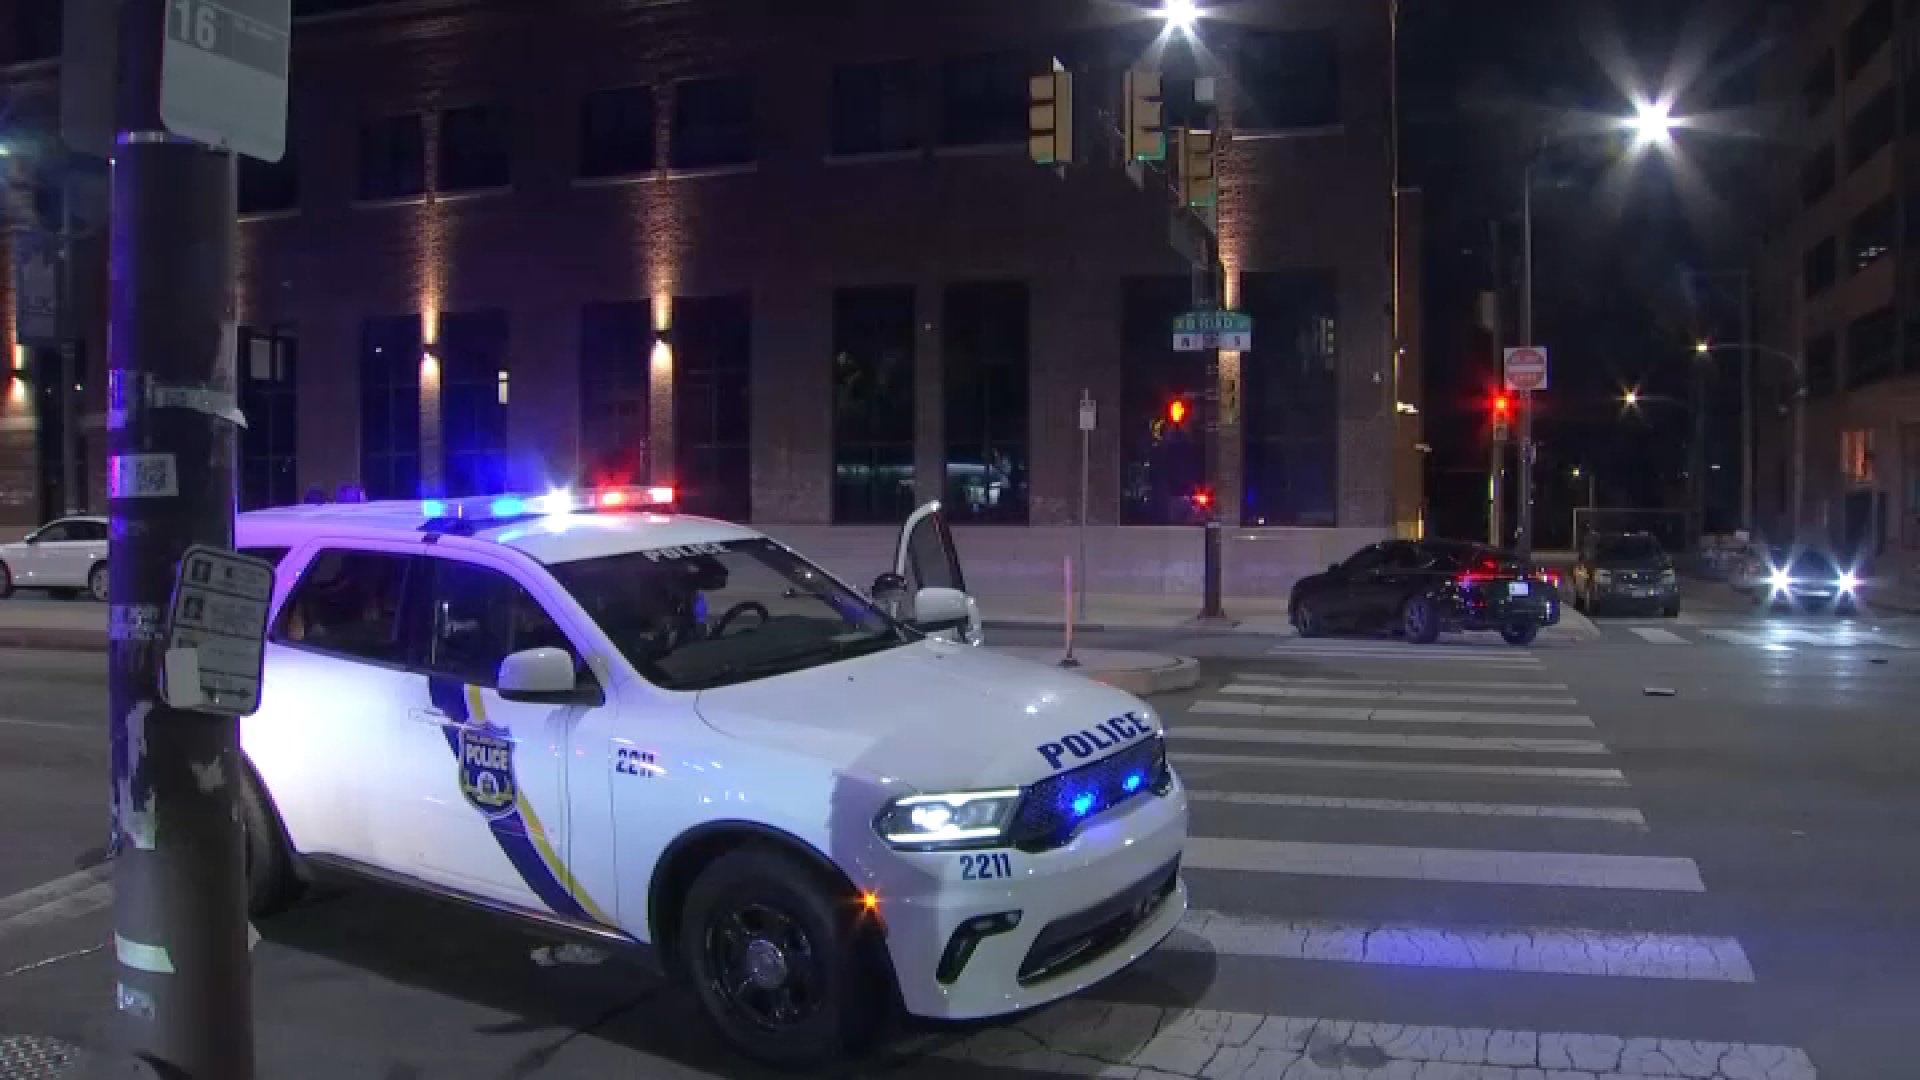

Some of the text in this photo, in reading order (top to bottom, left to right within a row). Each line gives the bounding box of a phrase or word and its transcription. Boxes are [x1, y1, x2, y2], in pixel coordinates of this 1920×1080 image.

[175, 0, 217, 49] 16
[1037, 711, 1151, 770] POLICE
[466, 743, 508, 771] POLICE
[615, 746, 657, 778] 2211
[959, 853, 1012, 881] 2211
